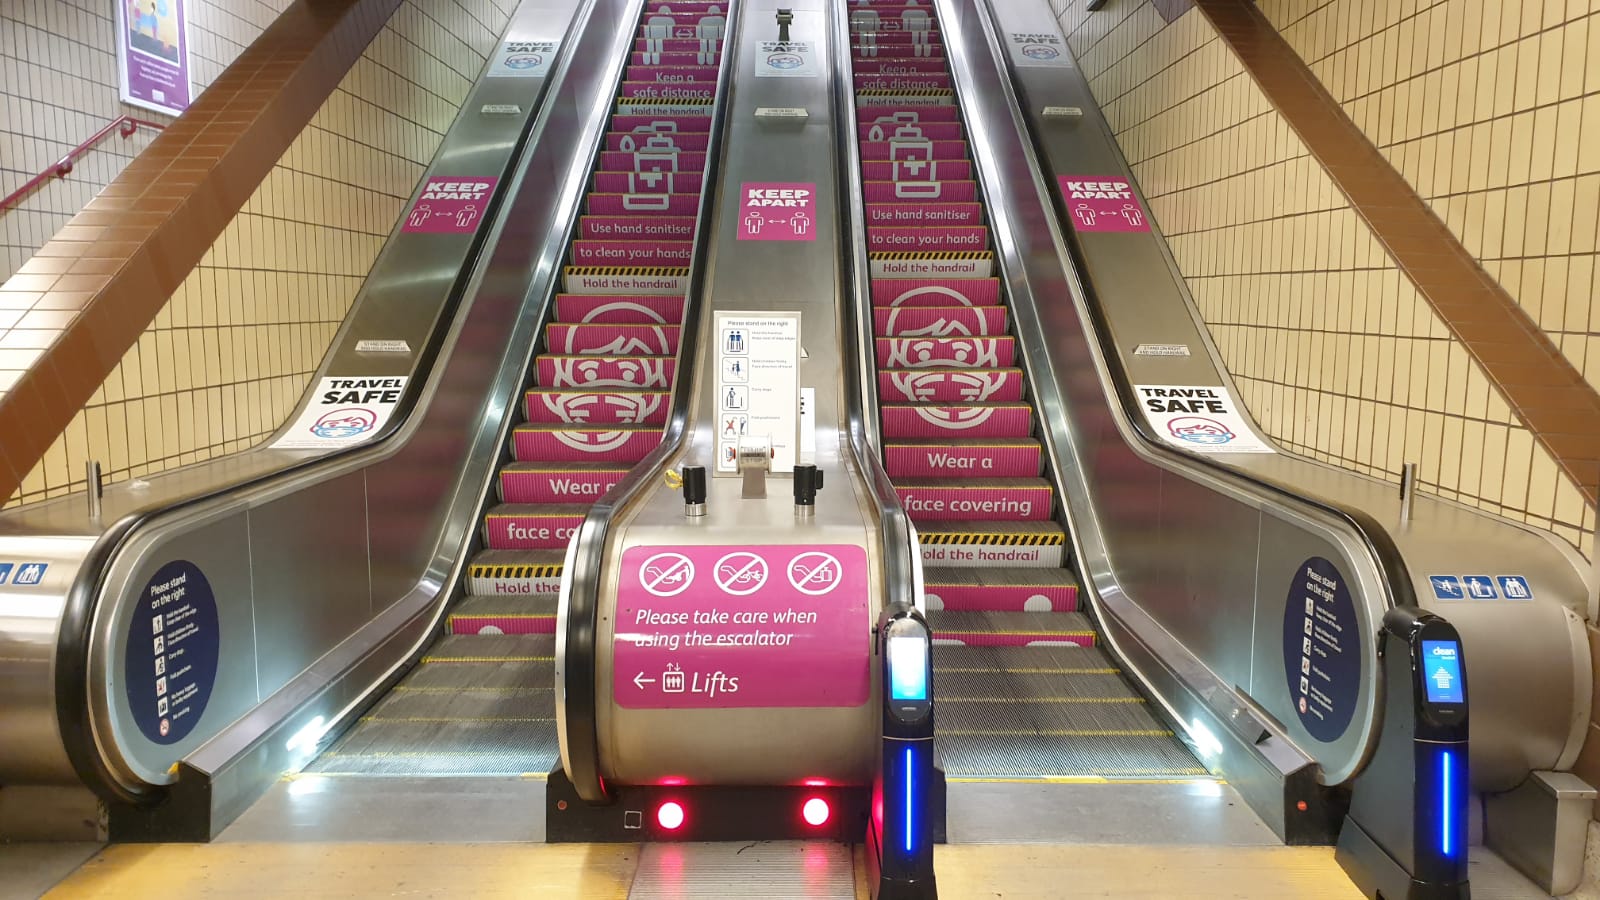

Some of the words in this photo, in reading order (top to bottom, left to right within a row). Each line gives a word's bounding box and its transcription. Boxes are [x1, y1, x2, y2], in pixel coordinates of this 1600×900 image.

[864, 79, 888, 89] safe
[890, 78, 938, 89] distance
[633, 87, 658, 98] safe
[661, 86, 711, 98] distance
[426, 182, 490, 192] KEEP
[1067, 181, 1129, 191] KEEP
[421, 192, 486, 200] APART
[748, 188, 810, 199] KEEP
[1071, 191, 1131, 199] APART
[746, 198, 809, 207] APART
[872, 209, 893, 220] Use
[895, 209, 922, 220] hand
[925, 210, 970, 220] sanitiser
[590, 223, 612, 233] Use
[614, 223, 642, 234] hand
[645, 224, 691, 234] sanitiser
[872, 235, 884, 244] to
[886, 233, 915, 244] clean
[918, 235, 943, 247] your
[946, 233, 980, 244] hands
[580, 247, 593, 257] to
[595, 246, 625, 257] clean
[628, 249, 653, 260] your
[656, 247, 692, 259] hands
[883, 262, 908, 273] Hold
[911, 262, 929, 273] the
[931, 262, 975, 273] handrail
[583, 278, 608, 288] Hold
[612, 278, 630, 288] the
[635, 278, 677, 289] handrail
[330, 379, 403, 389] TRAVEL
[321, 390, 401, 405] SAFE
[1140, 388, 1219, 398] TRAVEL
[1146, 399, 1227, 413] SAFE
[928, 453, 976, 469] Wear
[981, 458, 993, 469] a
[549, 479, 600, 495] Wear
[904, 495, 944, 512] face
[950, 498, 1032, 516] covering
[507, 522, 550, 540] face
[921, 548, 945, 560] old
[950, 549, 973, 560] the
[978, 548, 1039, 561] handrail
[151, 582, 170, 597] Please
[170, 571, 186, 588] stand
[1306, 567, 1322, 584] Please
[1322, 577, 1337, 591] stand
[495, 581, 530, 594] Hold
[535, 581, 560, 593] the
[1306, 582, 1313, 590] on
[1321, 588, 1334, 603] right
[151, 599, 160, 610] on
[160, 593, 171, 606] the
[171, 586, 185, 602] right
[635, 609, 689, 625] Please
[693, 608, 729, 625] take
[732, 610, 769, 624] care
[772, 608, 817, 623] when
[635, 632, 680, 651] using
[684, 630, 712, 647] the
[716, 630, 794, 647] escalator
[691, 671, 740, 698] Lifts
